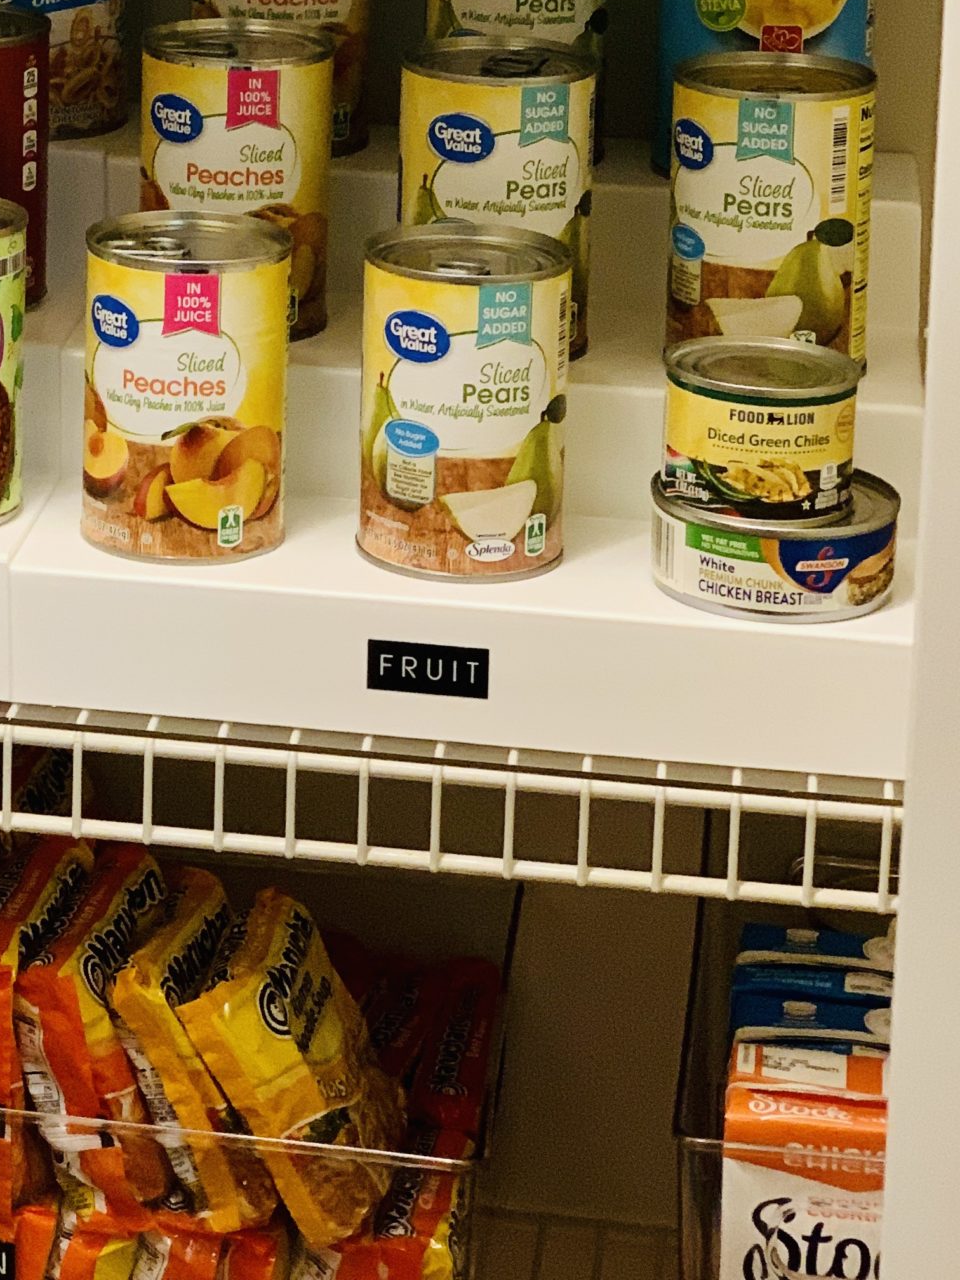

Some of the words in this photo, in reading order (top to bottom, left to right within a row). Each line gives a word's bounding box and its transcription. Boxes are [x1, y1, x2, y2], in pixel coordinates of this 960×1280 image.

[700, 0, 741, 12] STEVIA
[754, 107, 776, 120] NO
[434, 123, 483, 145] Great
[742, 122, 788, 136] SUGAR
[444, 139, 482, 155] Value
[742, 137, 788, 151] ADDED
[239, 144, 284, 164] Sliced
[187, 162, 284, 186] Peaches
[522, 160, 567, 181] Sliced
[507, 179, 567, 200] Pears
[739, 175, 795, 199] Sliced
[723, 193, 793, 218] Pears
[186, 283, 201, 295] IN
[495, 291, 516, 304] NO
[176, 296, 211, 309] 100%
[93, 305, 128, 329] Great
[174, 309, 212, 323] JUICE
[482, 305, 527, 320] SUGAR
[99, 323, 128, 339] Value
[390, 319, 437, 343] Great
[482, 321, 526, 334] ADDED
[400, 337, 436, 354] Value
[177, 353, 225, 372] Sliced
[122, 369, 226, 396] Peaches
[480, 364, 530, 385] Sliced
[462, 382, 529, 404] Pears
[729, 409, 765, 424] FOOD
[787, 412, 815, 425] LION
[707, 427, 745, 445] Diced
[749, 433, 791, 448] Green
[794, 434, 830, 447] Chiles
[468, 542, 512, 559] Splenda
[699, 554, 735, 573] White
[800, 561, 845, 570] SWANSON
[698, 579, 752, 601] CHICKEN
[755, 591, 803, 605] BREAST
[380, 654, 479, 684] FRUIT
